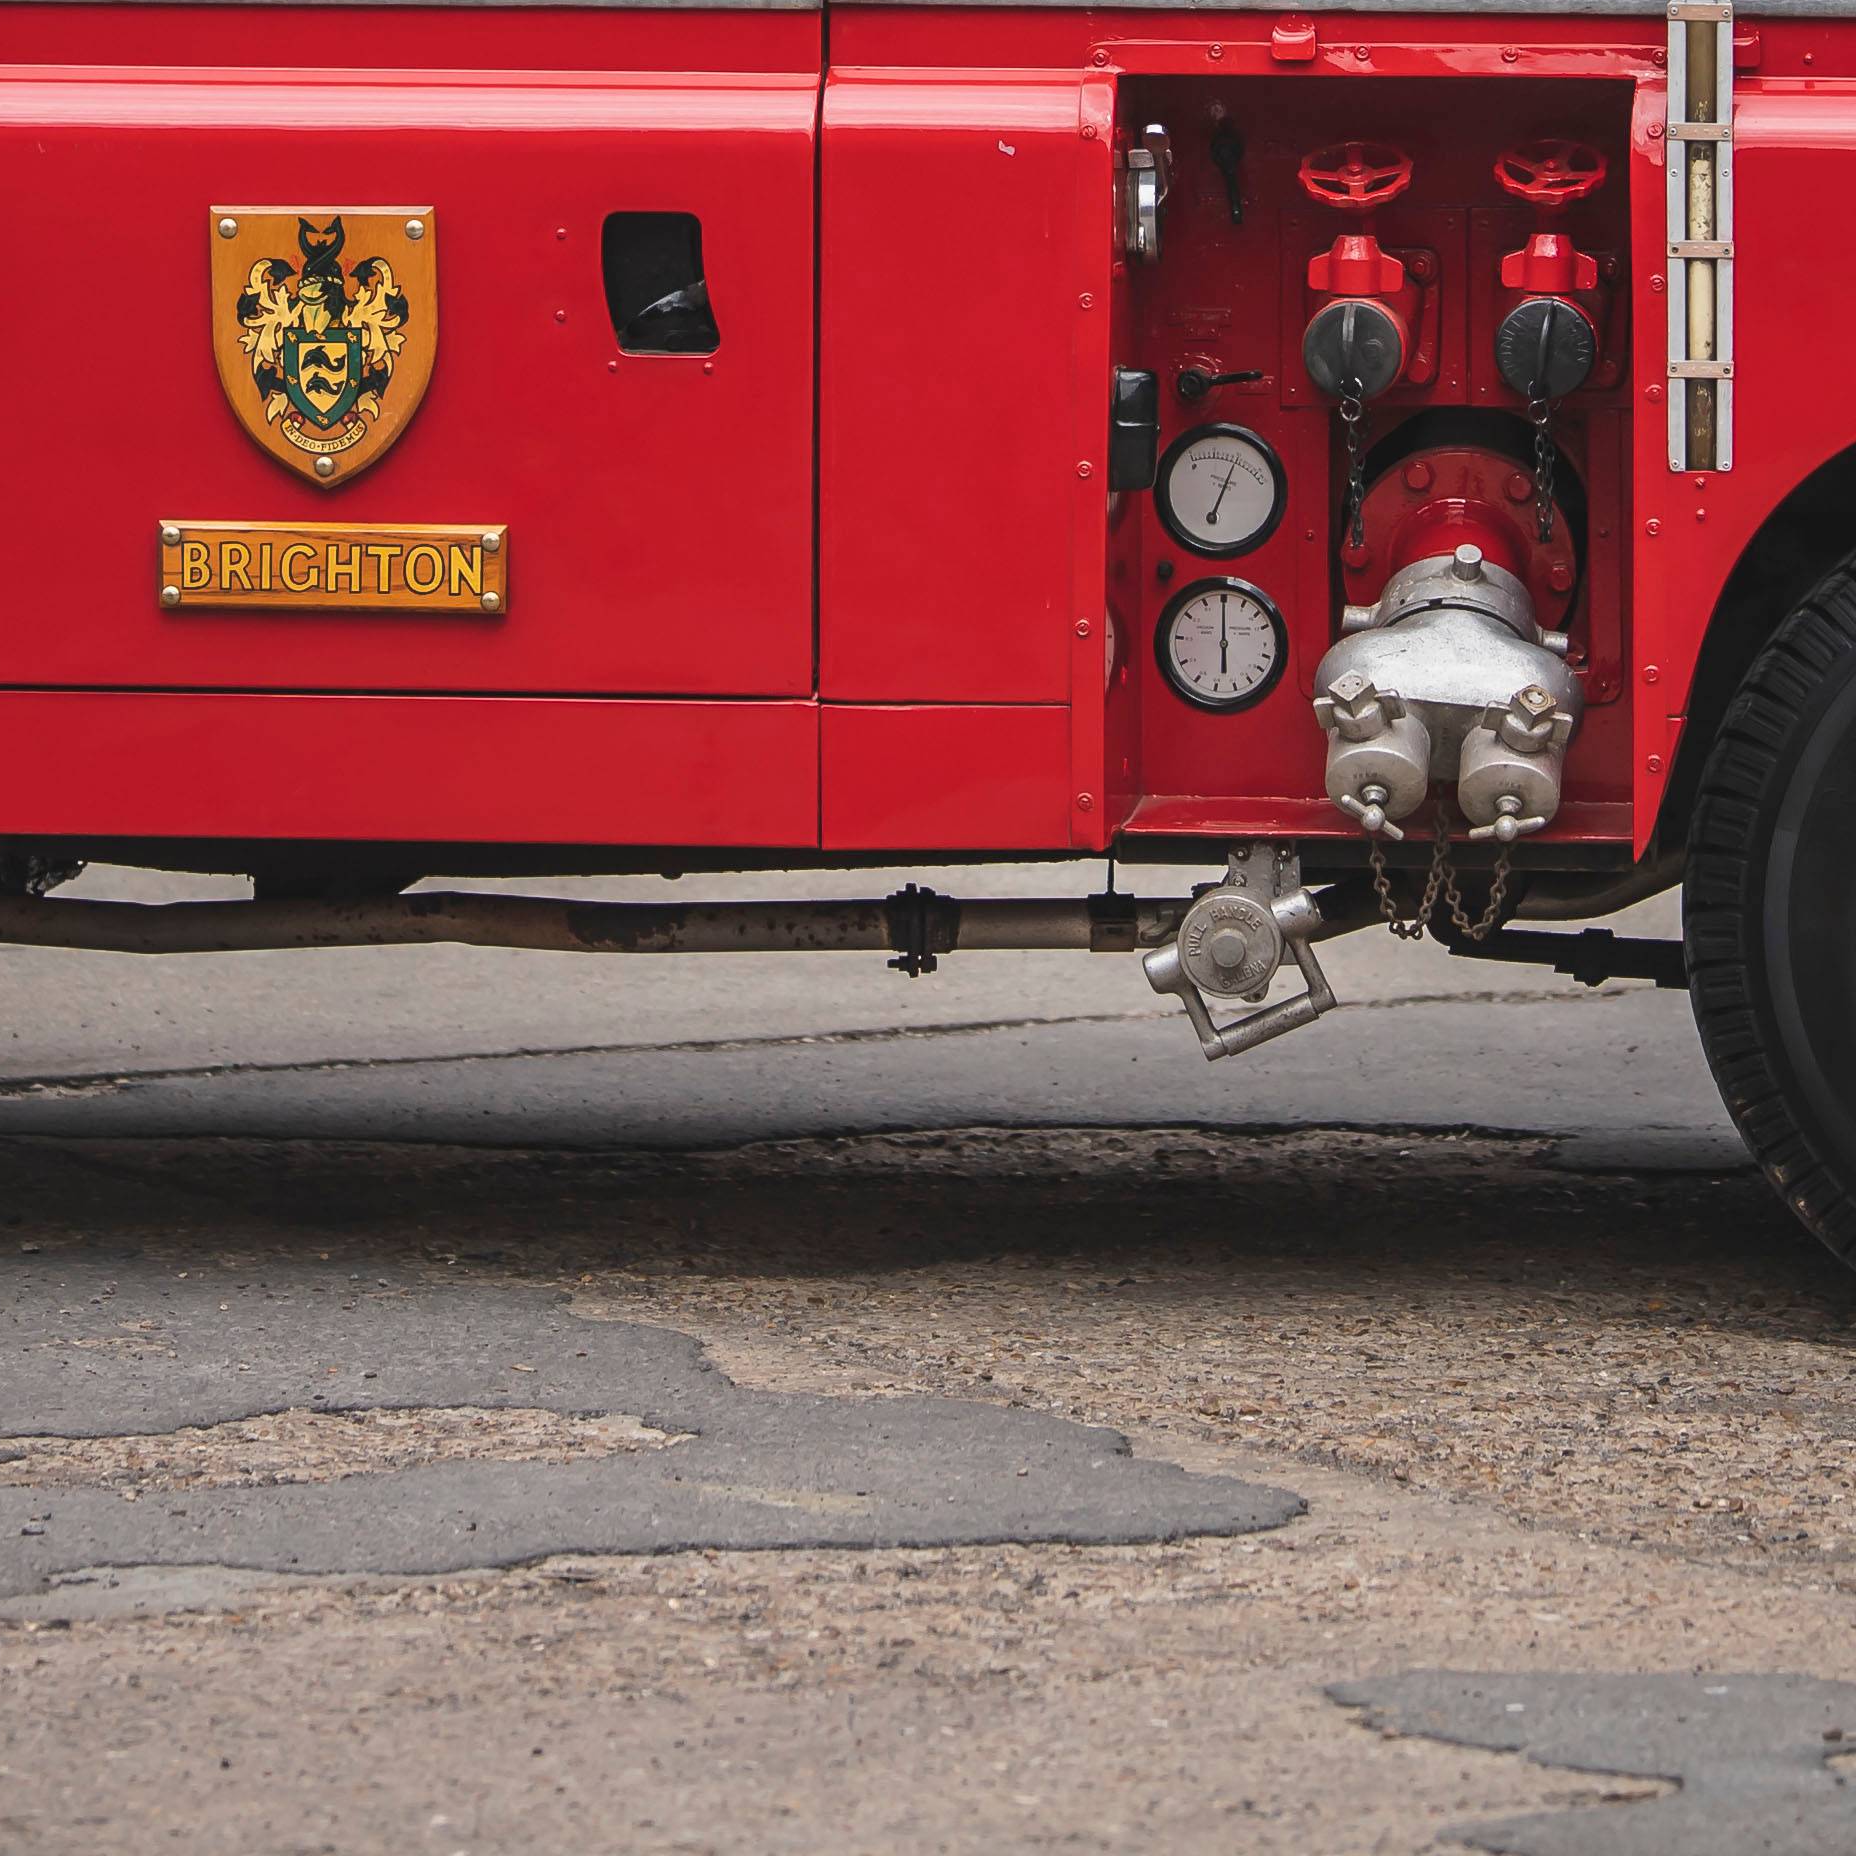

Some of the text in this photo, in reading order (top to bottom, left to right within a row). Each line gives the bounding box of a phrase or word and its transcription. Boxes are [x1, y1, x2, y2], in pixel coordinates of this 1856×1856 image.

[285, 423, 364, 451] IN DEO FIDEMUS
[180, 540, 486, 597] BRIGHTON
[1188, 922, 1207, 958] PULL
